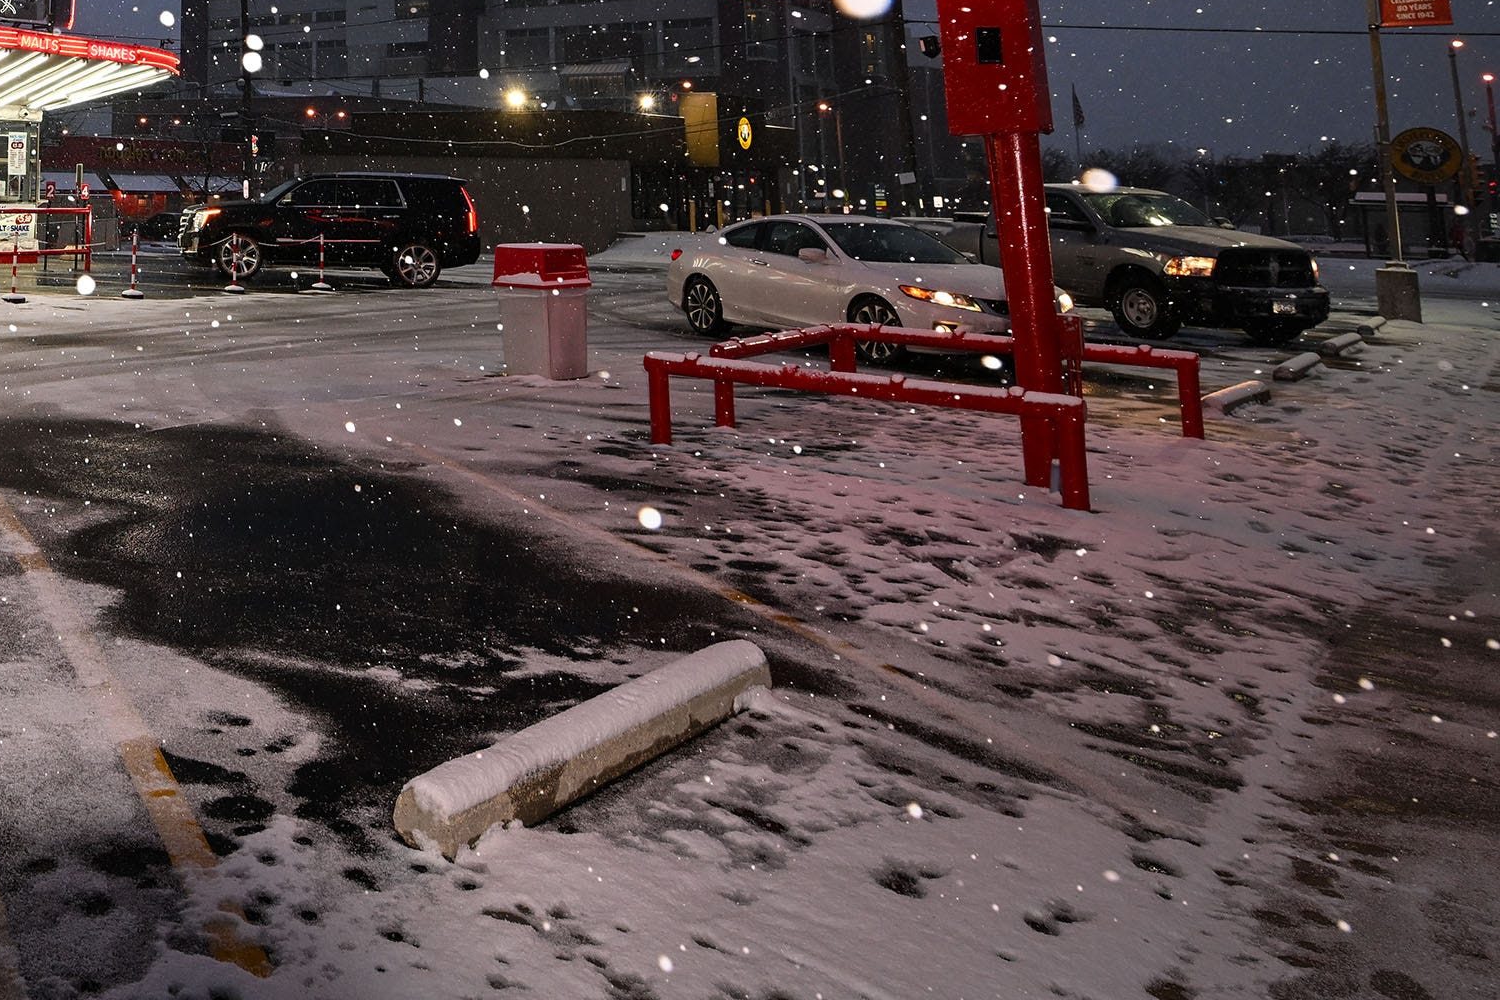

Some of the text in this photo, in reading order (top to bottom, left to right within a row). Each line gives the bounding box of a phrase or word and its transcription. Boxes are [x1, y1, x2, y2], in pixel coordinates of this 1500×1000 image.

[1409, 3, 1432, 11] YEARS
[21, 34, 59, 52] MALTS
[90, 44, 137, 62] SHAKES
[47, 185, 54, 197] 2
[81, 186, 89, 197] 4
